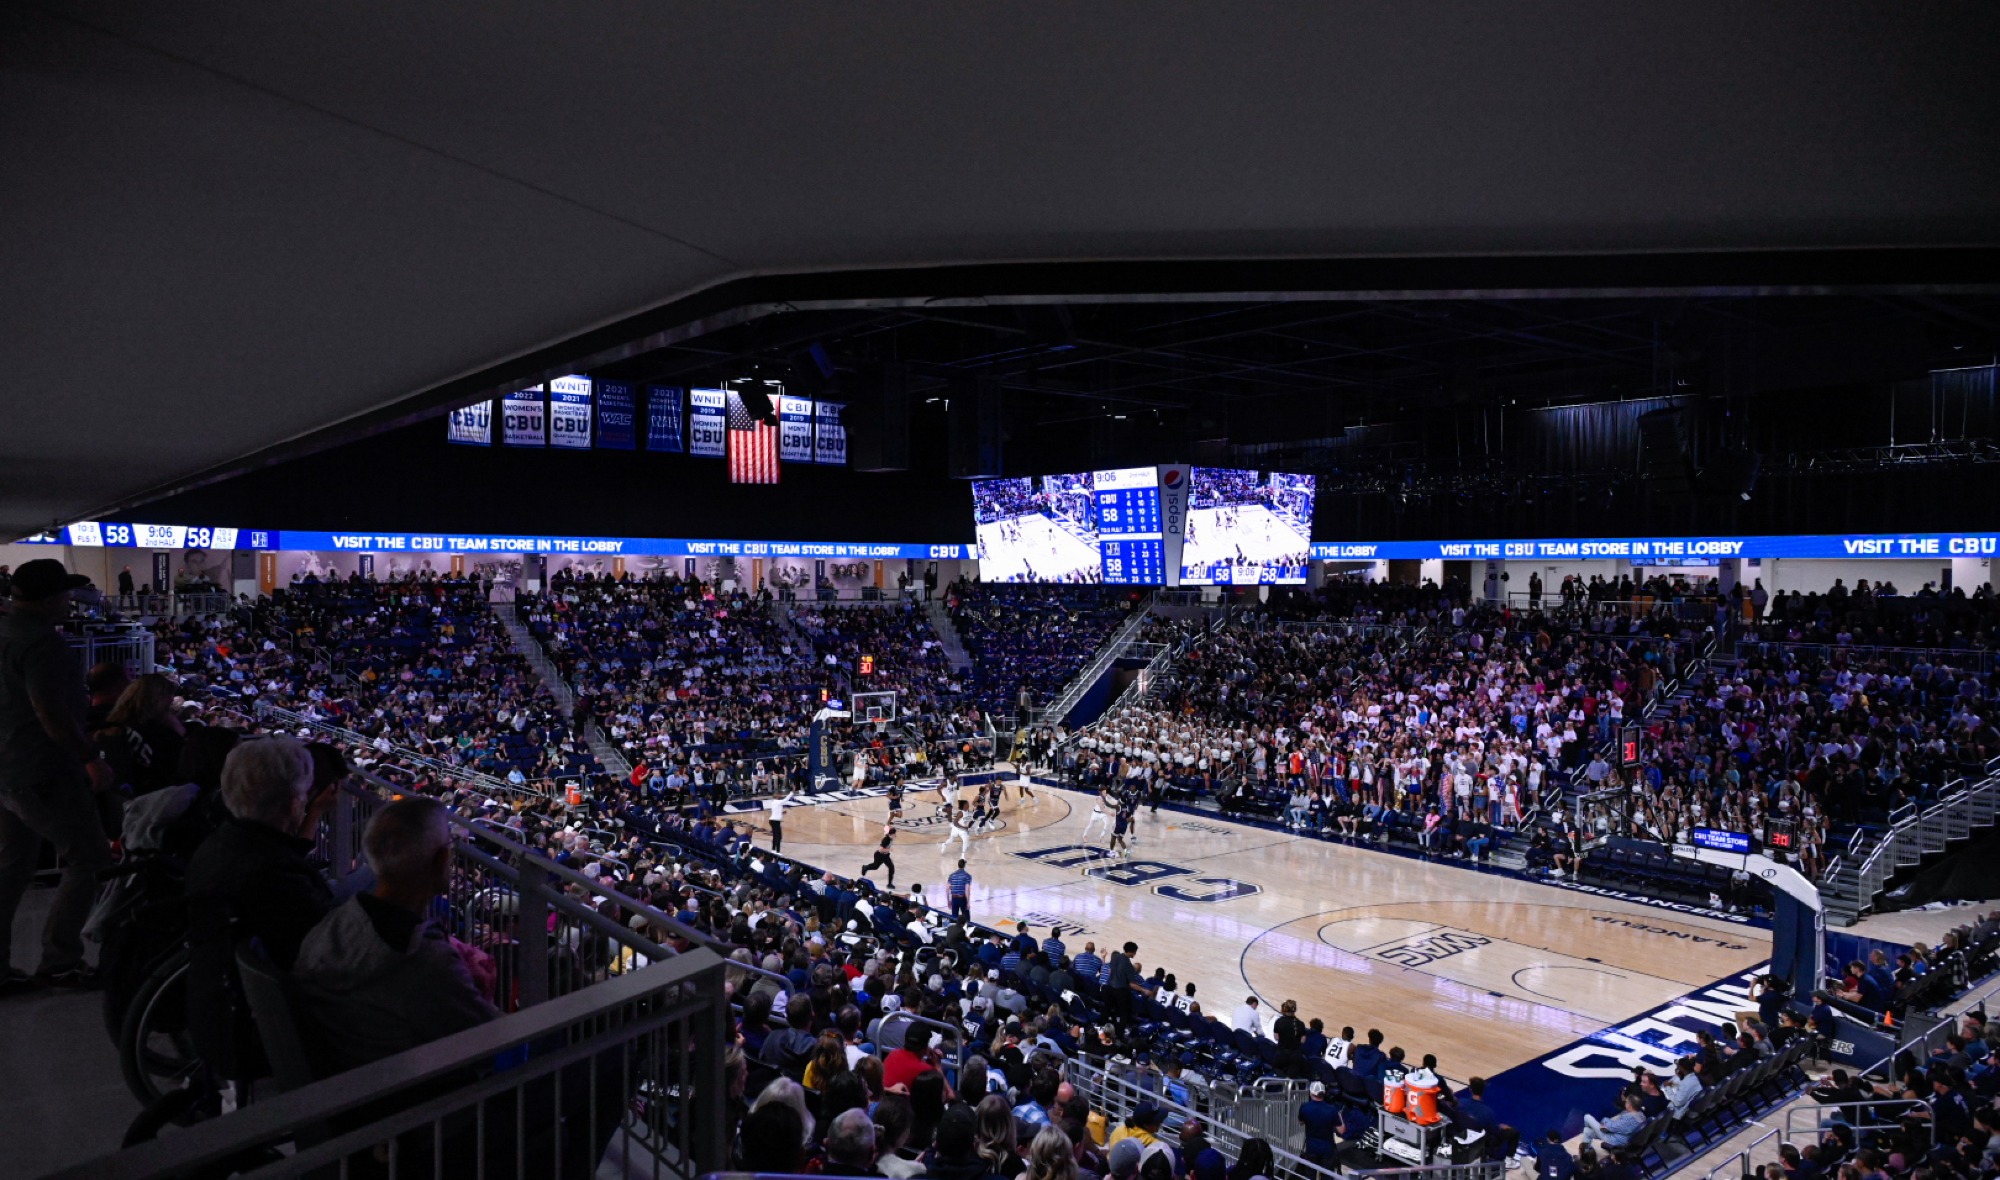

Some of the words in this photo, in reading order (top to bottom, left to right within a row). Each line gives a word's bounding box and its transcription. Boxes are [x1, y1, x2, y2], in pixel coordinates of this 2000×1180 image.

[554, 381, 588, 391] WNIT
[604, 385, 627, 394] 2021
[654, 389, 674, 398] 2021
[693, 395, 722, 405] WNIT
[505, 404, 543, 412] WOMEN'S
[786, 403, 807, 412] CBI
[452, 411, 489, 428] CBU
[505, 415, 541, 431] CBU
[553, 417, 588, 433] CBU
[601, 412, 632, 426] WAC
[693, 429, 723, 443] CBU
[782, 435, 811, 448] CBU
[817, 437, 844, 451] CBU
[1096, 472, 1116, 482] 9:06
[1100, 494, 1117, 504] CBU
[1102, 508, 1118, 522] 58
[1167, 493, 1181, 534] pepsi
[106, 525, 129, 543] 58
[148, 526, 173, 538] 9:06
[188, 528, 211, 547] 58
[145, 538, 157, 547] 2nd
[159, 539, 176, 547] HALF
[332, 536, 372, 548] VISIT
[375, 536, 405, 548] THE
[411, 536, 443, 549] CBU
[448, 537, 487, 550] TEAM
[490, 538, 534, 550] STORE
[537, 540, 551, 551] IN
[553, 540, 579, 551] THE
[581, 541, 623, 552] LOBBY
[684, 543, 715, 553] VISIT
[718, 543, 740, 553] THE
[744, 543, 768, 554] CBU
[770, 544, 800, 554] TEAM
[802, 545, 835, 554] STORE
[837, 546, 847, 555] IN
[848, 546, 868, 555] THE
[869, 546, 900, 556] LOBBY
[1440, 544, 1471, 556] VISIT
[1474, 544, 1500, 555] THE
[1504, 544, 1534, 556] CBU
[1538, 543, 1579, 555] TEAM
[1581, 542, 1629, 555] STORE
[1632, 542, 1649, 555] IN
[1652, 542, 1684, 555] THE
[1687, 541, 1743, 555] LOBBY
[1843, 539, 1895, 554] VISIT
[1898, 539, 1939, 553] THE
[1949, 538, 1997, 553] CBU
[930, 546, 960, 557] CBU
[1319, 546, 1338, 556] THE
[1341, 546, 1377, 556] LOBBY
[1106, 559, 1122, 572] 58
[1237, 567, 1255, 577] 9:06
[1215, 568, 1230, 581] 58
[1262, 567, 1276, 581] 58
[861, 663, 871, 673] 30
[1624, 742, 1635, 761] 30
[1708, 834, 1725, 843] TEAM
[1726, 837, 1748, 847] STORE
[1772, 833, 1789, 847] 30
[1008, 845, 1262, 902] CBU
[1378, 932, 1492, 967] WAC
[1328, 1044, 1344, 1060] 21
[1408, 1090, 1418, 1106] G
